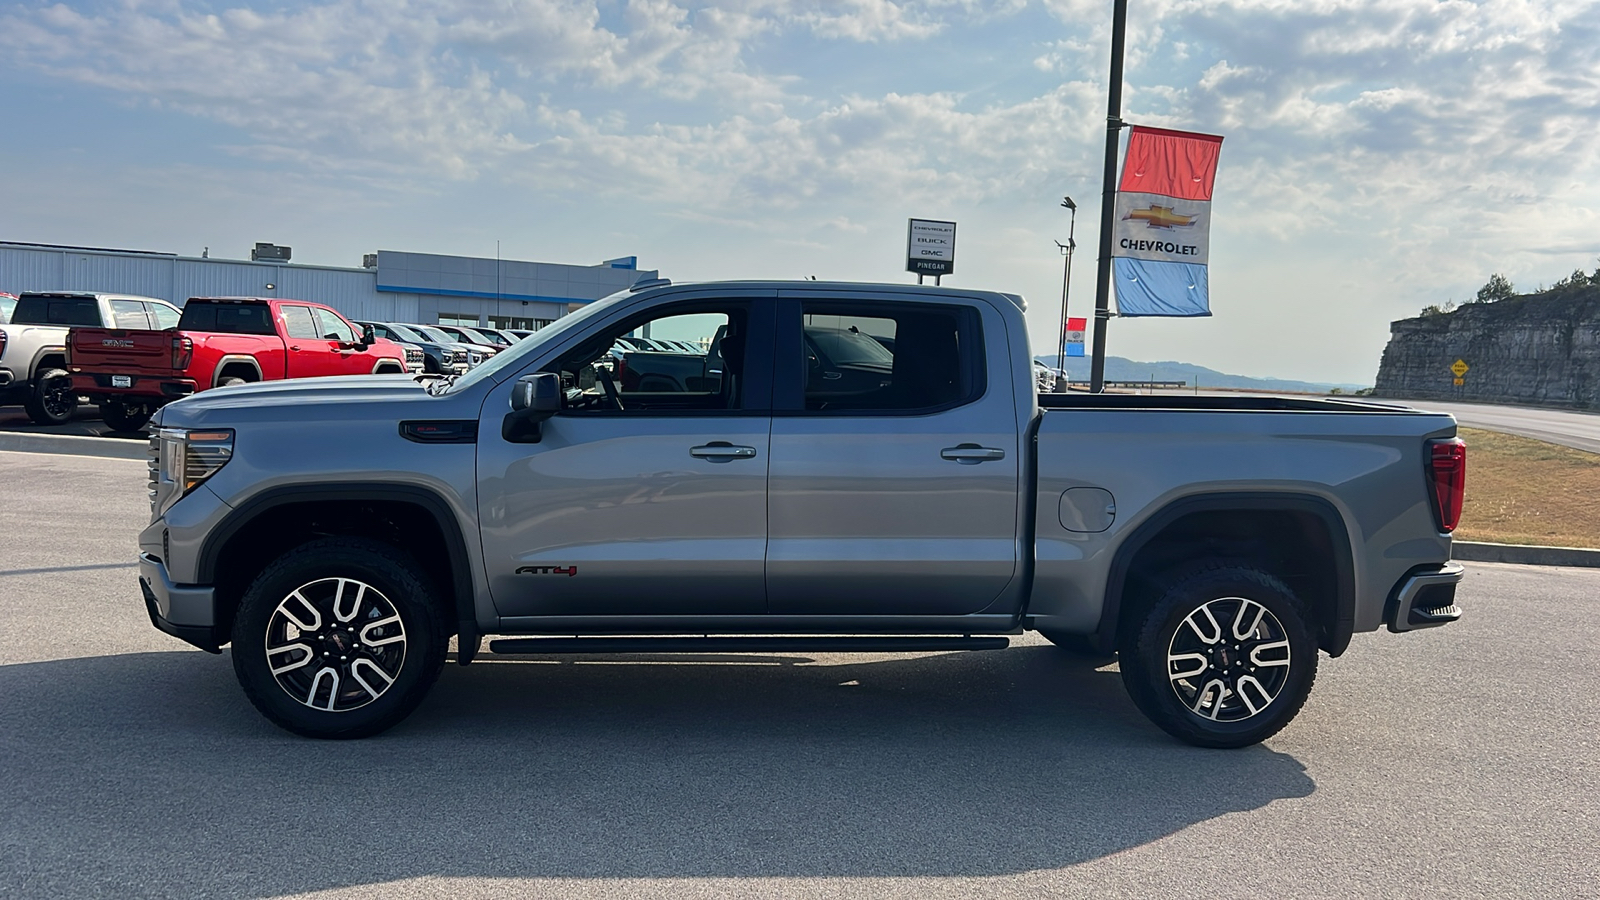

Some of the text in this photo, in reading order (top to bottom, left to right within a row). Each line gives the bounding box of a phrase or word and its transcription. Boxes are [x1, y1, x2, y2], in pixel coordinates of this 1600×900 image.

[1120, 238, 1197, 255] CHEVROLET
[917, 262, 945, 270] PINEGAR
[102, 340, 134, 348] GMC
[515, 566, 577, 577] AT4
